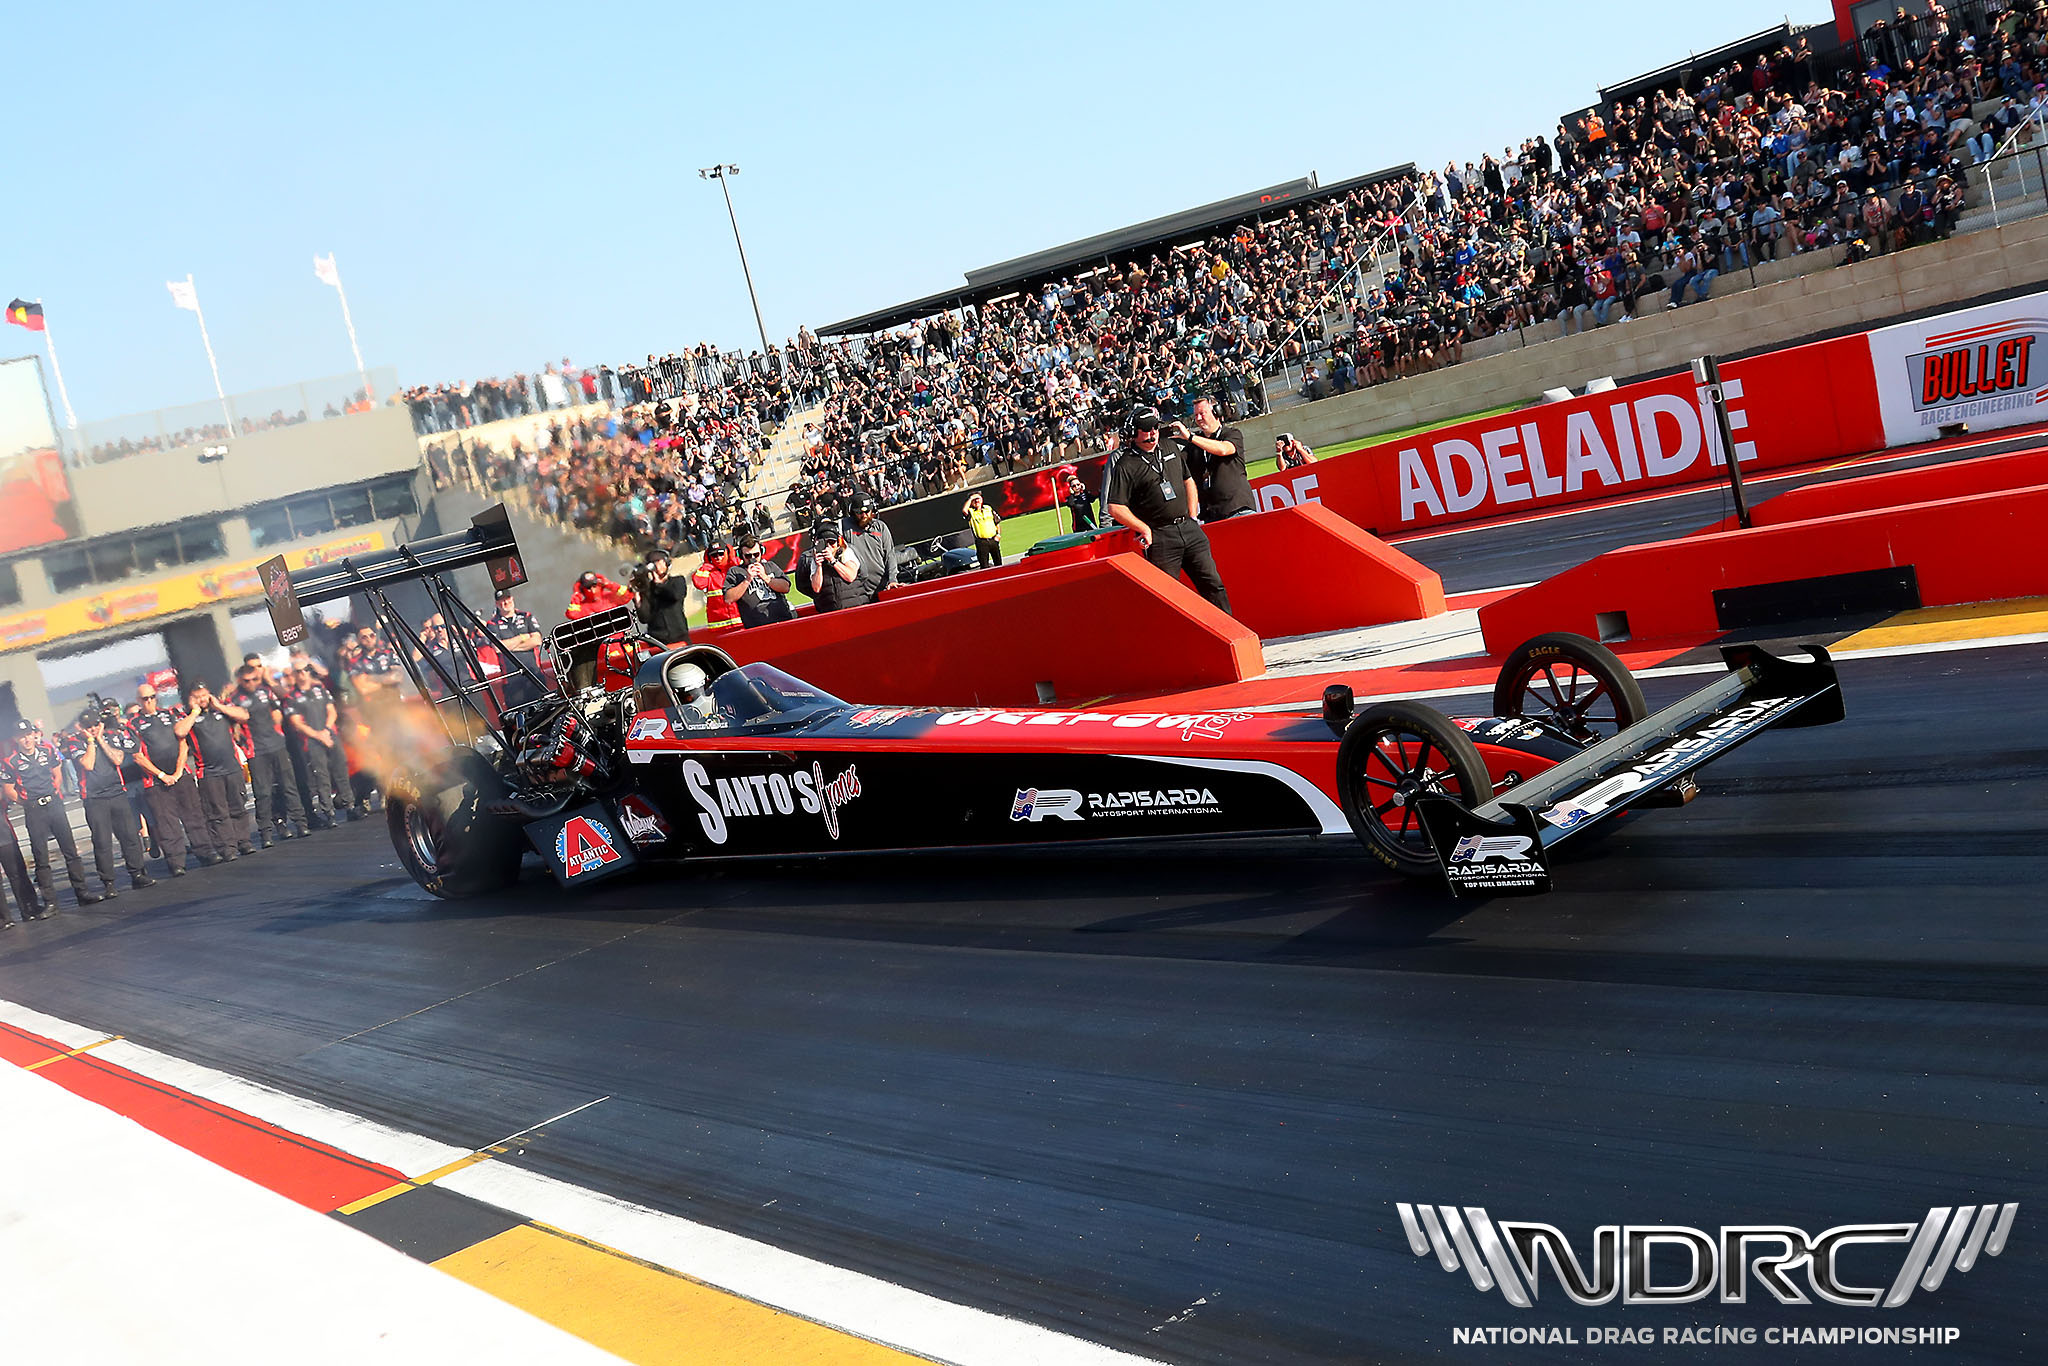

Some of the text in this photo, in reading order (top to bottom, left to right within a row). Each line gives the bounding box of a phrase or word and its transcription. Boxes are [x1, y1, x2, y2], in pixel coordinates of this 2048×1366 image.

[1921, 334, 2036, 406] BULLET
[1920, 391, 2034, 426] RACE ENGINEERING
[1399, 378, 1757, 522] ADELAIDE
[1528, 646, 1561, 658] EAGLE
[1659, 695, 1806, 776] AUTOSPORT INTERNATIONAL
[682, 759, 821, 844] SANTO'S
[812, 760, 862, 840] Cranes
[1087, 787, 1219, 809] RAPISARDA
[1147, 807, 1223, 816] INTERNATIONAL
[569, 844, 609, 867] ATLANTIC
[1447, 862, 1545, 876] RAPISARDA
